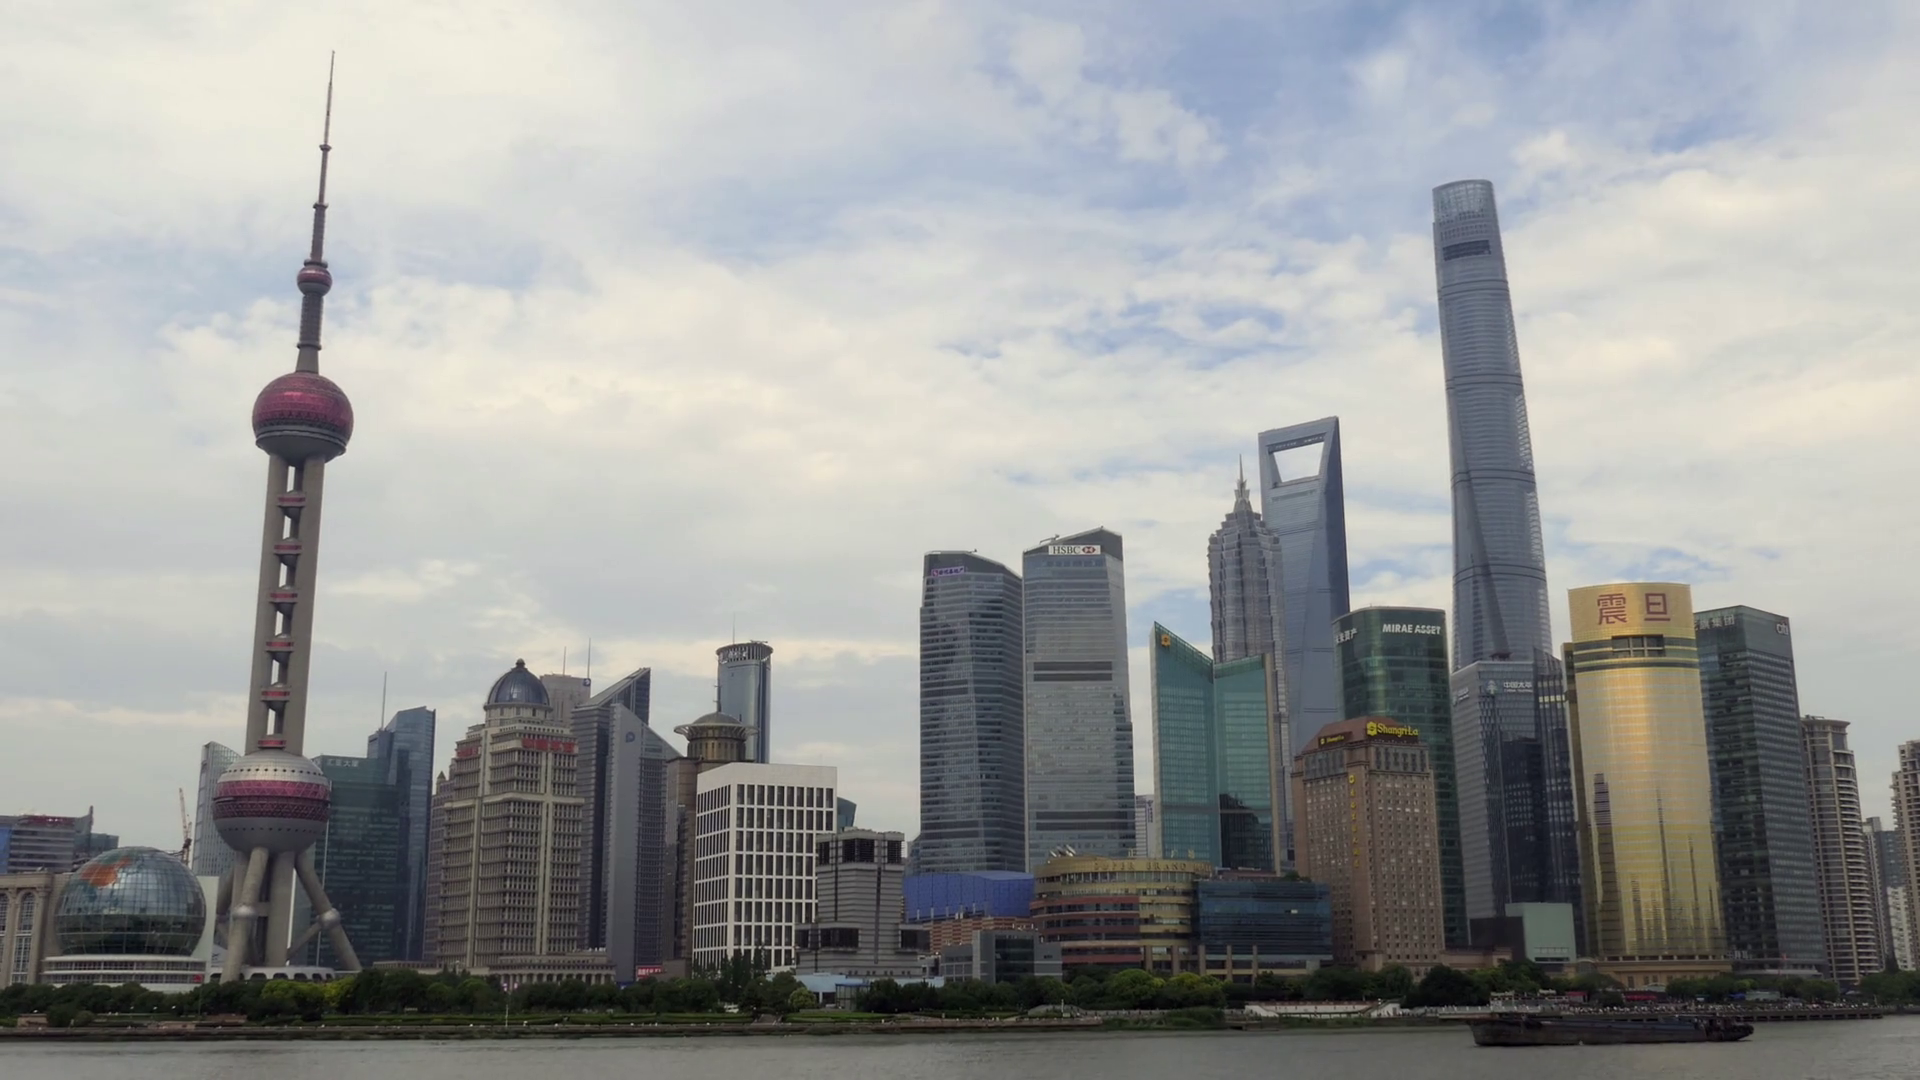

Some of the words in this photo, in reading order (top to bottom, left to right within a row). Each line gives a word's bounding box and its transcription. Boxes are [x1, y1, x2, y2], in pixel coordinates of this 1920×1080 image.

[1053, 546, 1081, 554] HSBC
[1597, 593, 1671, 625] 震旦
[1382, 623, 1413, 633] MIRAE
[1414, 625, 1441, 635] ASSET
